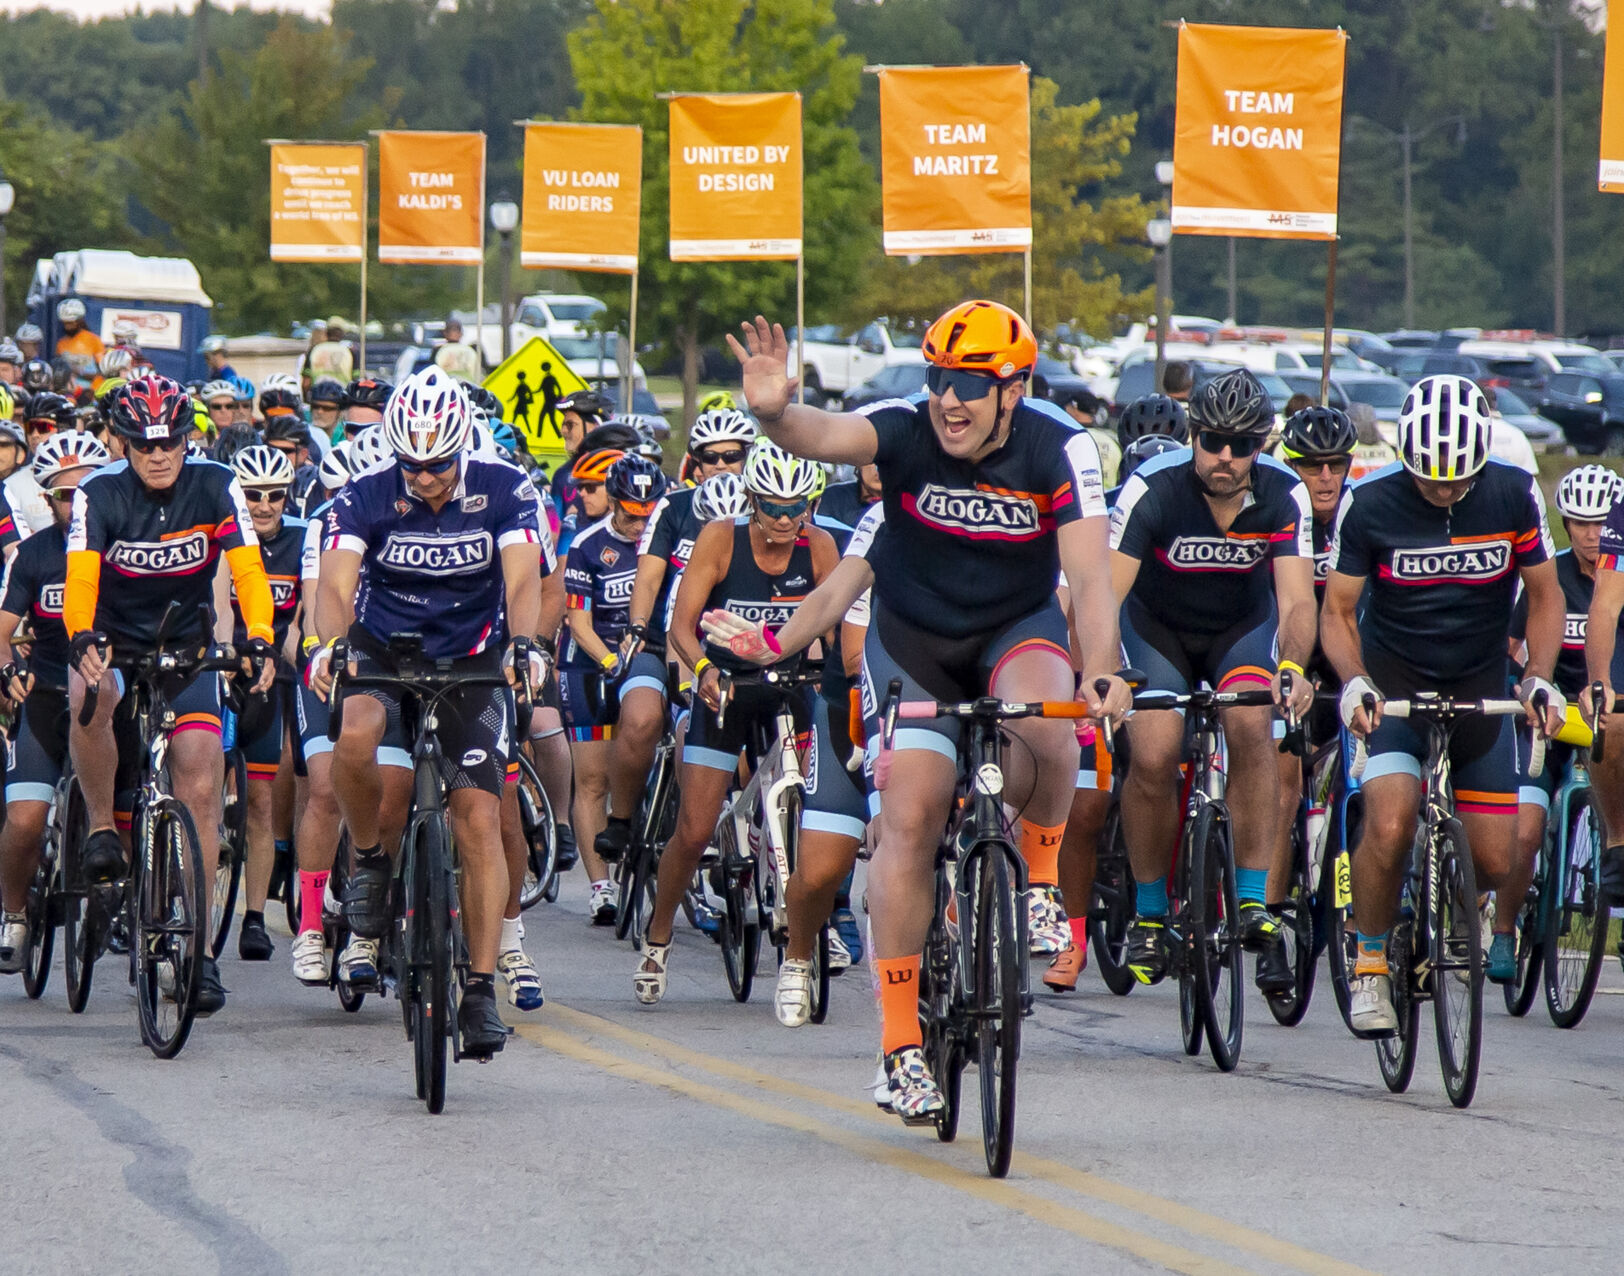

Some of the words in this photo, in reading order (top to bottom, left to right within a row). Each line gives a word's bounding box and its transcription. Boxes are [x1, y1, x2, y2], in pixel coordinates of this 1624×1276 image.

[1224, 90, 1294, 115] TEAM
[924, 123, 987, 145] TEAM
[1211, 125, 1303, 150] HOGAN
[683, 145, 760, 165] UNITED
[764, 145, 790, 164] BY
[914, 154, 998, 176] MARITZ
[408, 171, 454, 188] TEAM
[543, 169, 568, 187] VU
[571, 170, 620, 188] LOAN
[698, 173, 775, 192] DESIGN
[398, 194, 463, 210] KALDI'S
[548, 194, 614, 212] RIDERS
[414, 420, 433, 430] 680
[926, 493, 1035, 528] HOGAN
[116, 539, 202, 569] HOGAN
[387, 541, 484, 568] HOGAN
[1402, 548, 1504, 575] HOGAN
[731, 606, 798, 622] HOGA
